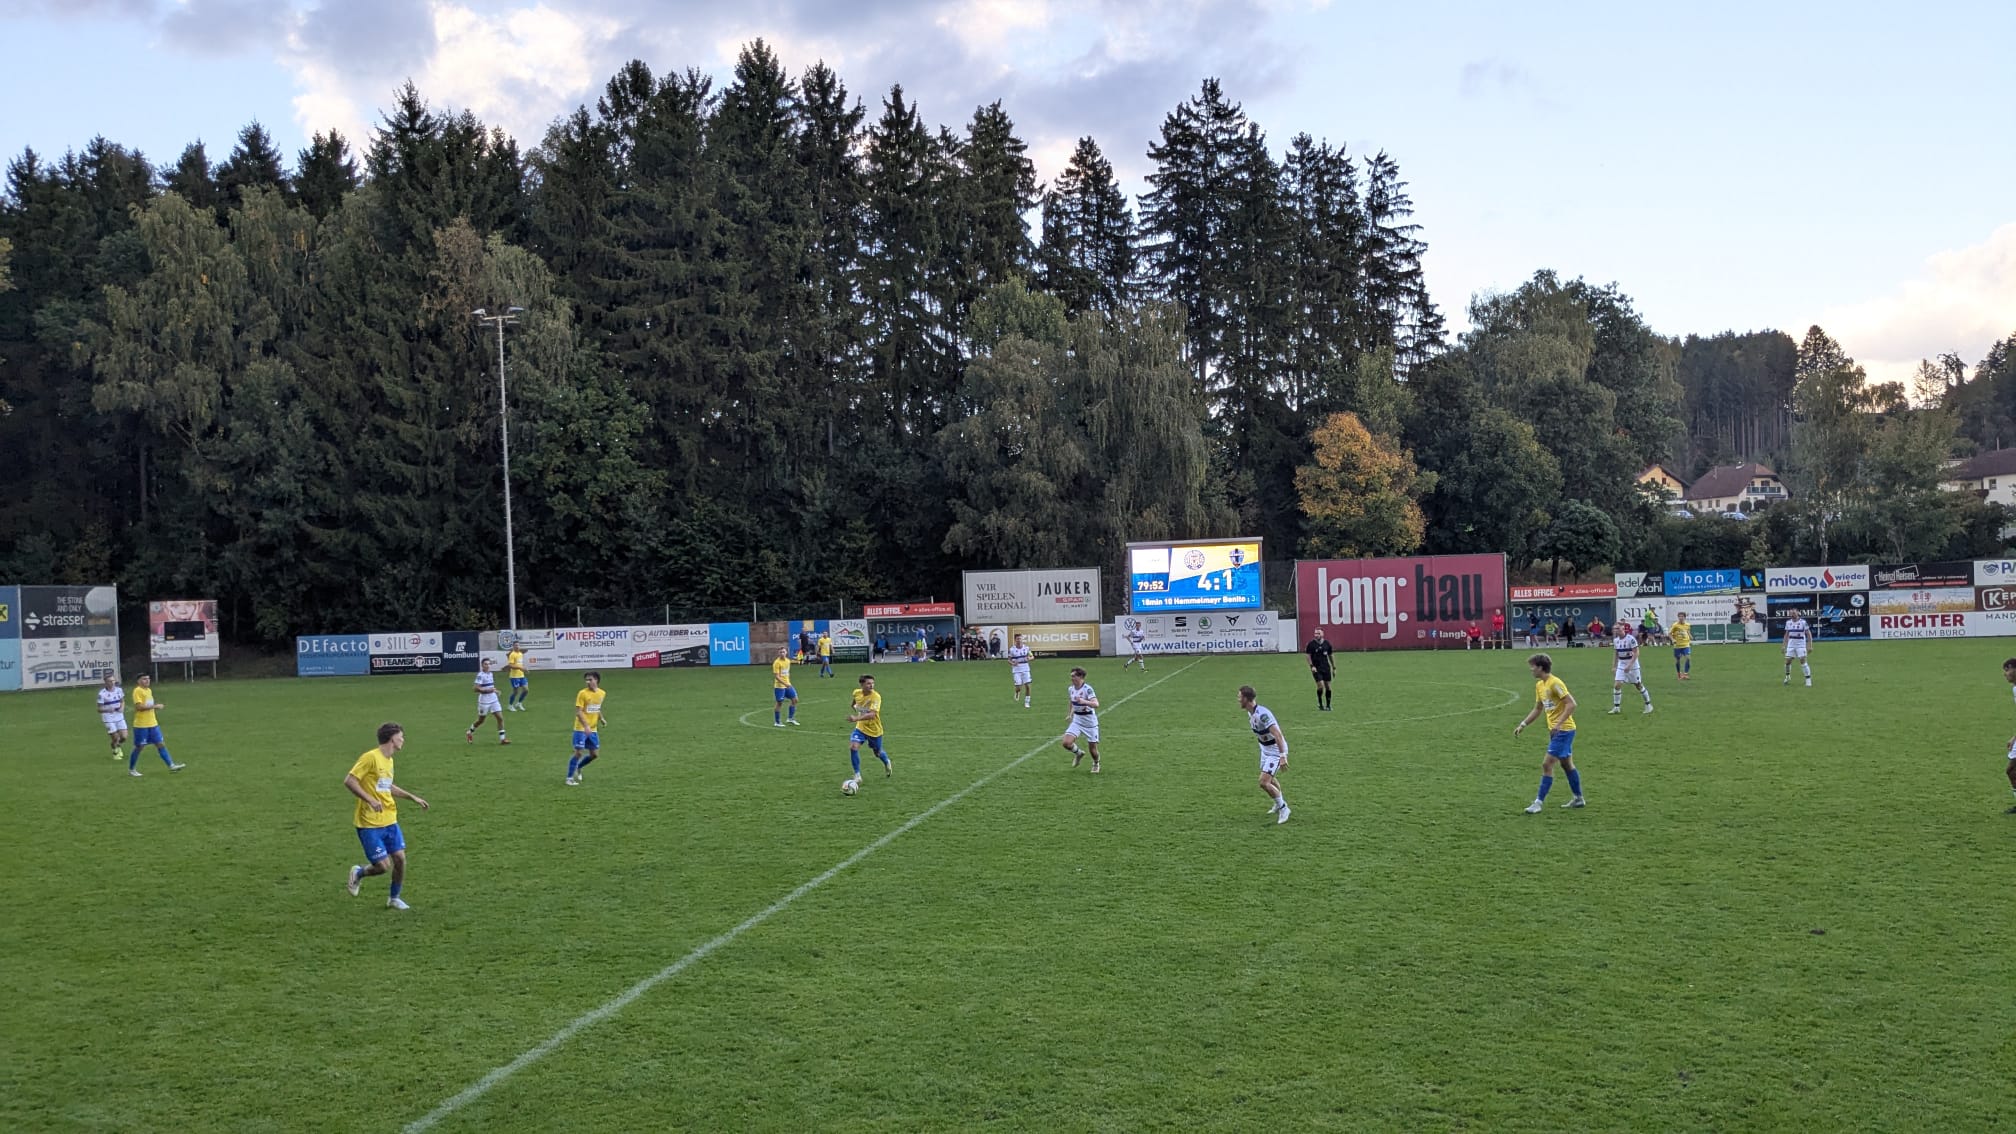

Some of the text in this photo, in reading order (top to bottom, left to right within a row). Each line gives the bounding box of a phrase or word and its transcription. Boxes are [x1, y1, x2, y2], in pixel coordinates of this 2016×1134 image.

[1138, 580, 1165, 591] 79:52
[1198, 569, 1233, 591] 4:1
[1618, 577, 1640, 588] edel
[1769, 574, 1818, 589] mibag
[1834, 581, 1853, 589] gut.
[977, 583, 996, 592] WIR
[1038, 581, 1091, 597] JAUKER
[1638, 581, 1662, 593] stahl
[977, 592, 1016, 601] SPIELEN
[1222, 593, 1247, 604] Benito
[1415, 564, 1484, 622] bau
[1514, 589, 1532, 598] ALLES
[867, 607, 882, 616] ALLES
[977, 601, 1026, 611] REGIONAL
[1513, 606, 1582, 618] Dfacto
[42, 614, 85, 626] strasser
[1880, 613, 1965, 629] RICHTER
[648, 629, 669, 637] AUTO
[876, 623, 935, 634] DEfaco
[1881, 630, 1923, 638] TECHNIK
[565, 630, 629, 641] INTERSPORT
[299, 639, 368, 653] DEfacto
[714, 637, 745, 652] hali
[79, 660, 114, 669] Walter
